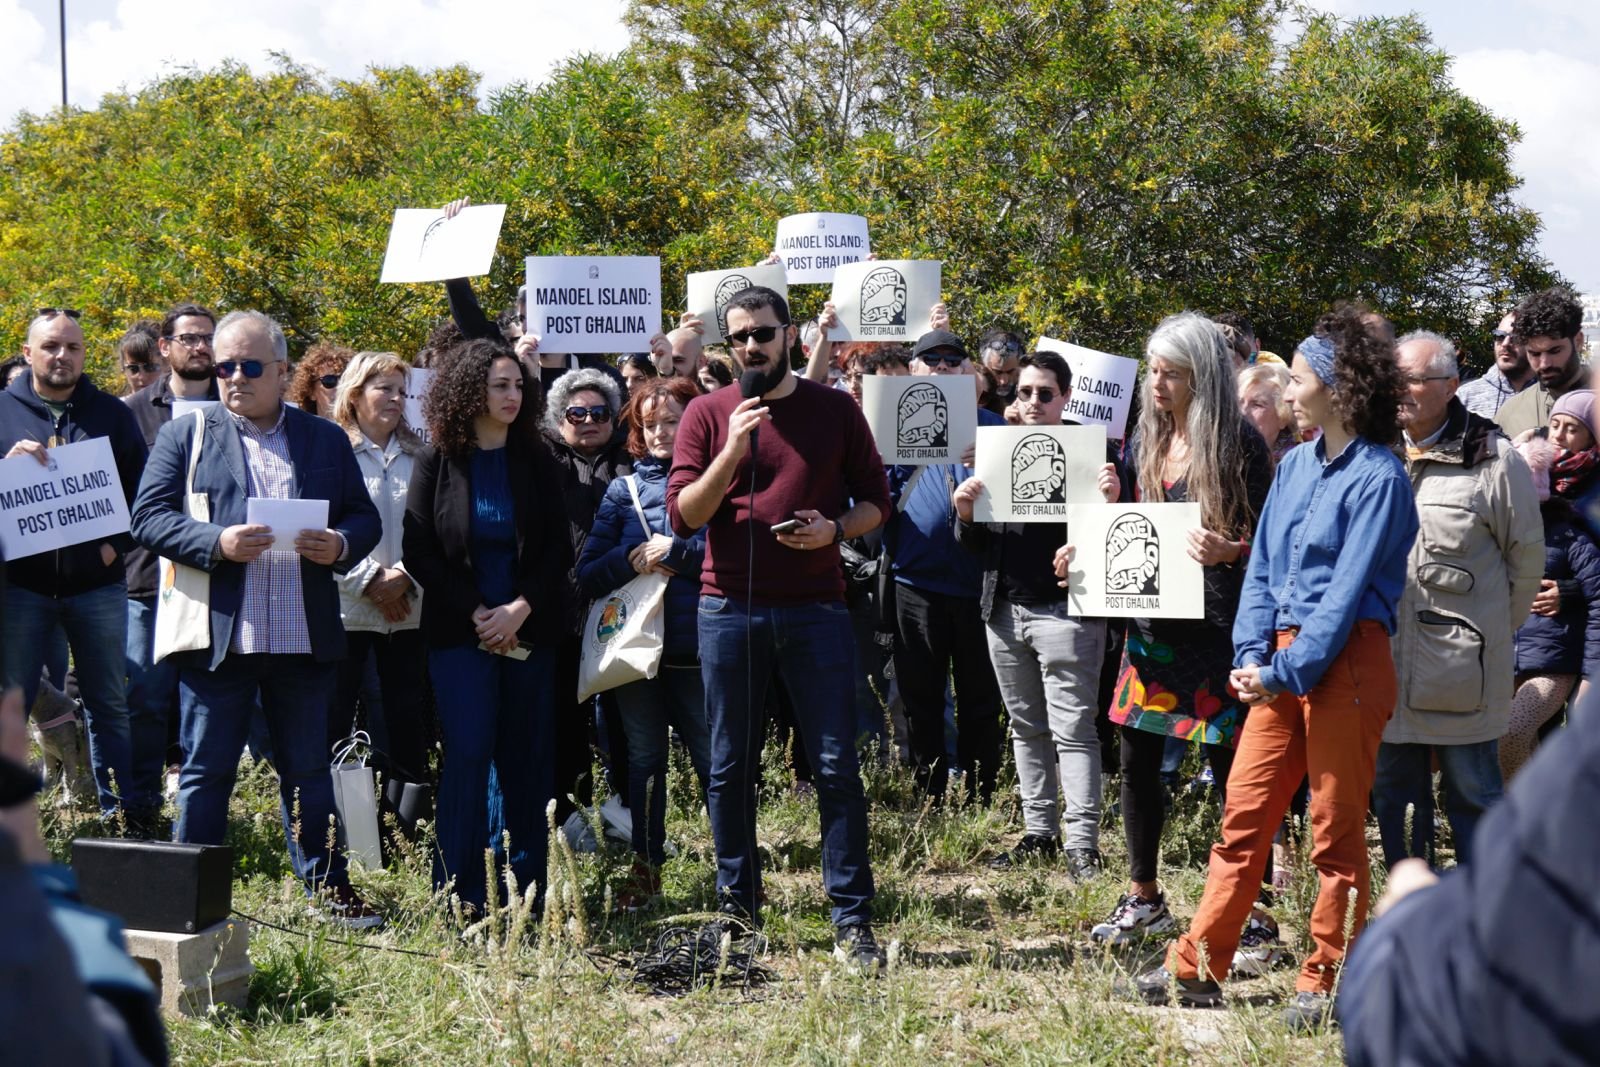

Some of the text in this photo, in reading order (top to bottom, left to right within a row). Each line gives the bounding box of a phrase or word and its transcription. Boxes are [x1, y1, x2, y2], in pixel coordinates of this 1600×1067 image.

[781, 234, 864, 250] MANOEL ISLAND:
[787, 256, 813, 270] POST
[536, 287, 652, 305] MANOEL ISLAND:
[546, 316, 646, 334] POST GĦALINA
[860, 326, 876, 336] POST
[1077, 375, 1124, 400] ISLAND:
[897, 449, 915, 458] POST
[0, 469, 112, 510] MANOEL ISLAND:
[17, 498, 115, 536] POST GĦALINA
[1012, 505, 1031, 515] POST
[1105, 596, 1125, 609] POST
